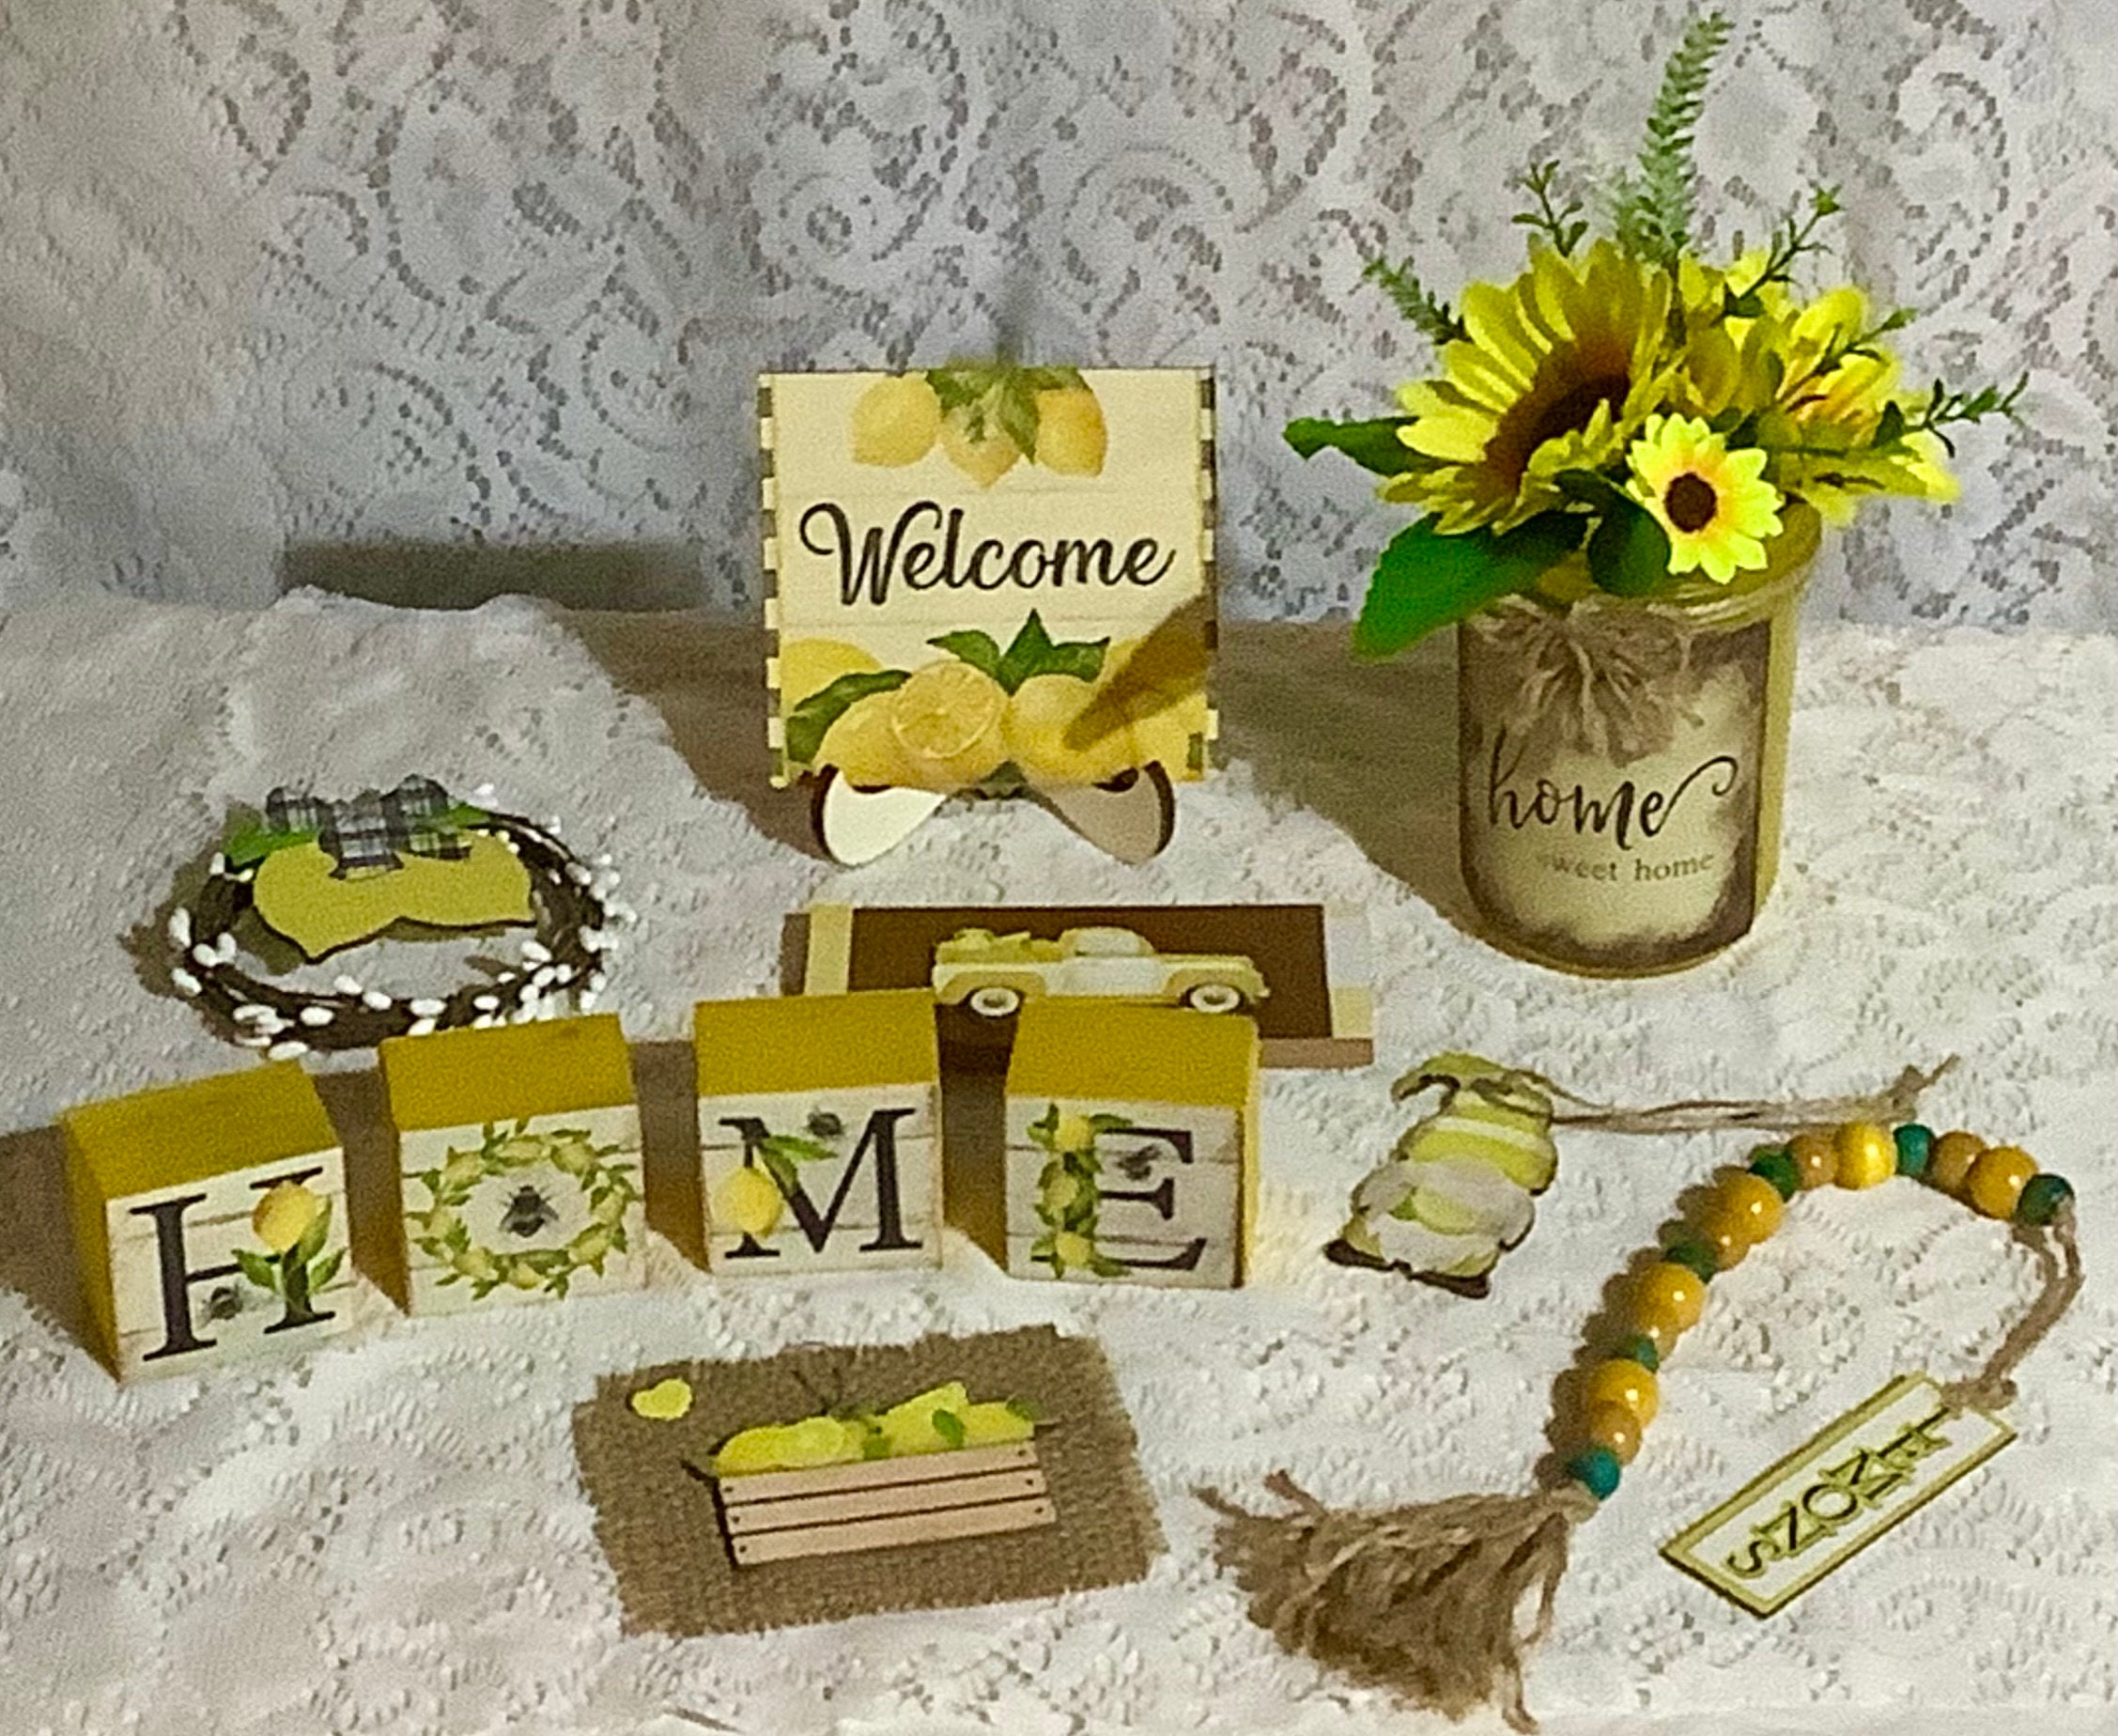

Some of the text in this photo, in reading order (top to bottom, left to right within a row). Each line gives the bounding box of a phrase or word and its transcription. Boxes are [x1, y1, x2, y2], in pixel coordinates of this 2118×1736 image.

[800, 500, 1176, 606] Welcome
[1489, 729, 1739, 850] home
[1634, 853, 1715, 881] home
